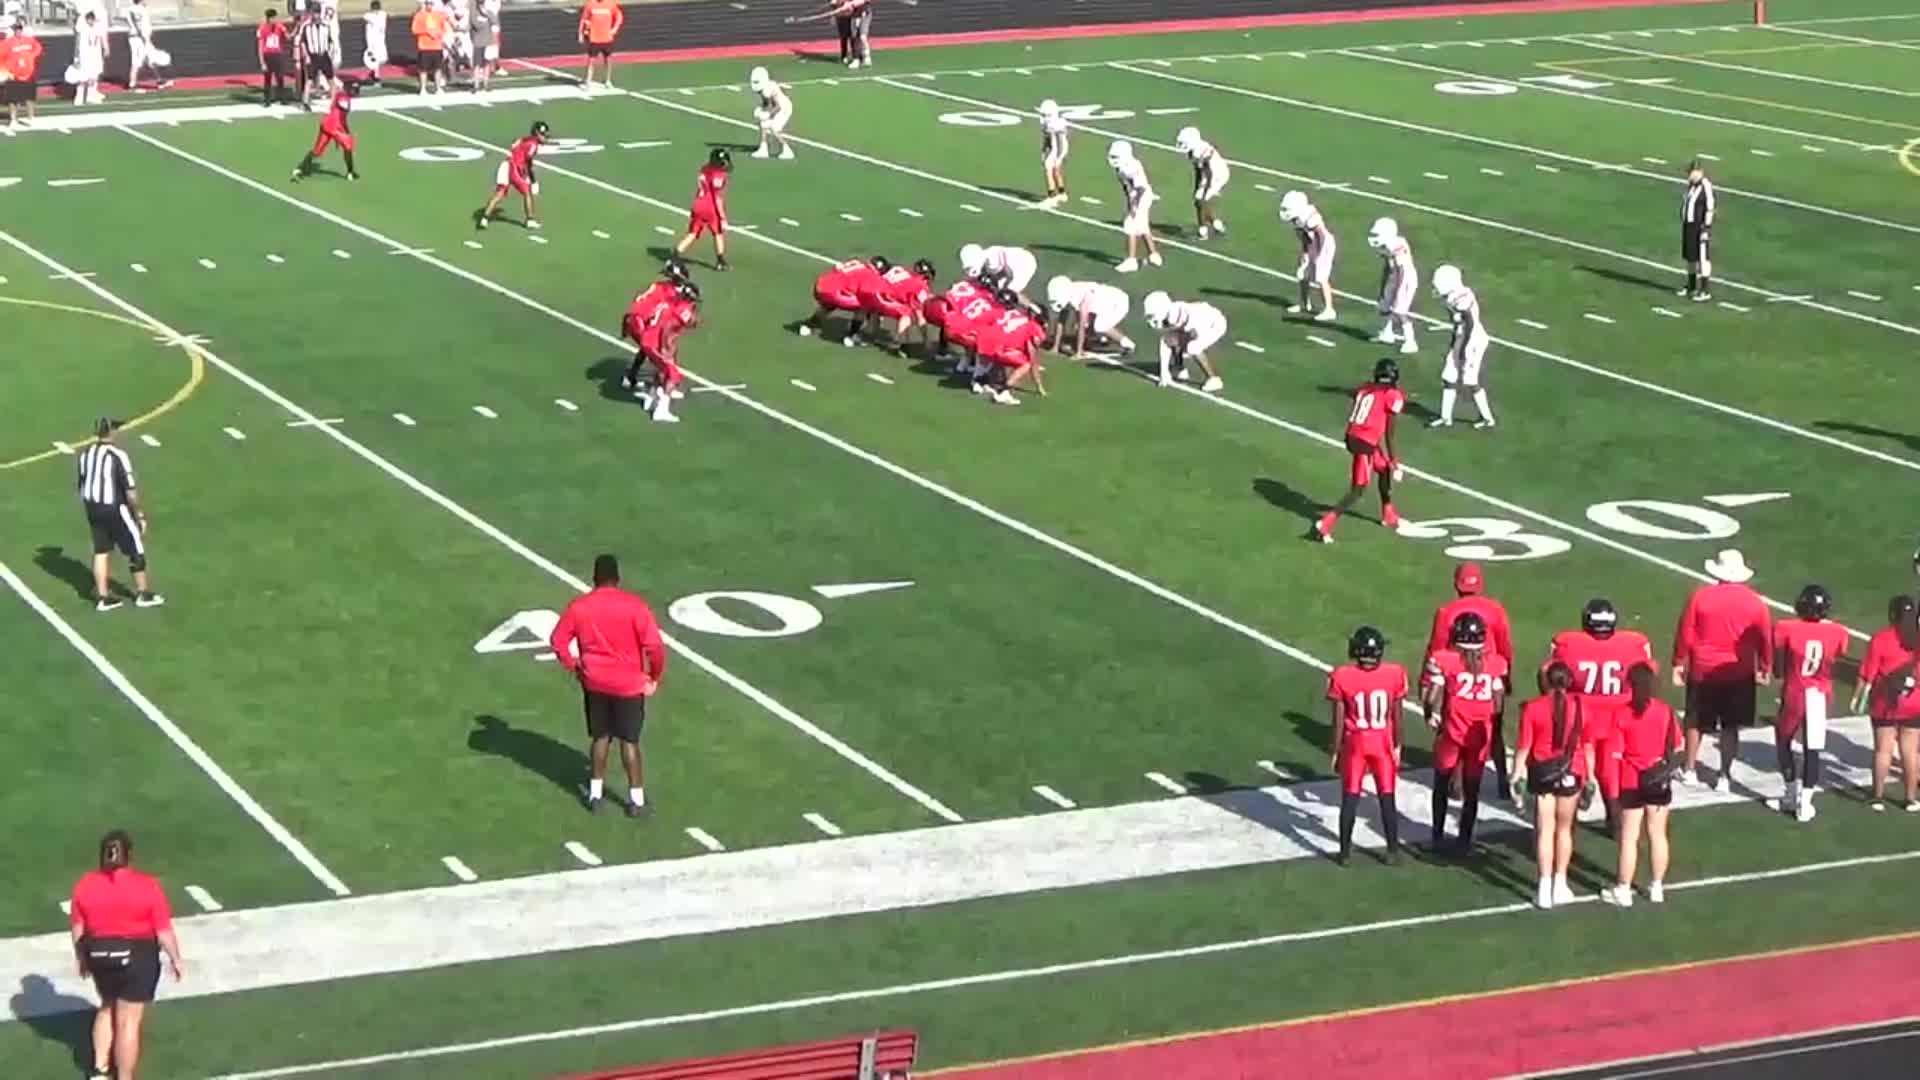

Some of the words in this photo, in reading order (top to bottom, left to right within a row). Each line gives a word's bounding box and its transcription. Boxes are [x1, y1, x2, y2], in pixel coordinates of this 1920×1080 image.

[1349, 389, 1375, 425] 18
[1395, 499, 1741, 562] 30
[1801, 639, 1823, 677] 8
[1456, 671, 1493, 700] 23
[1578, 660, 1622, 695] 76
[1354, 689, 1388, 730] 10
